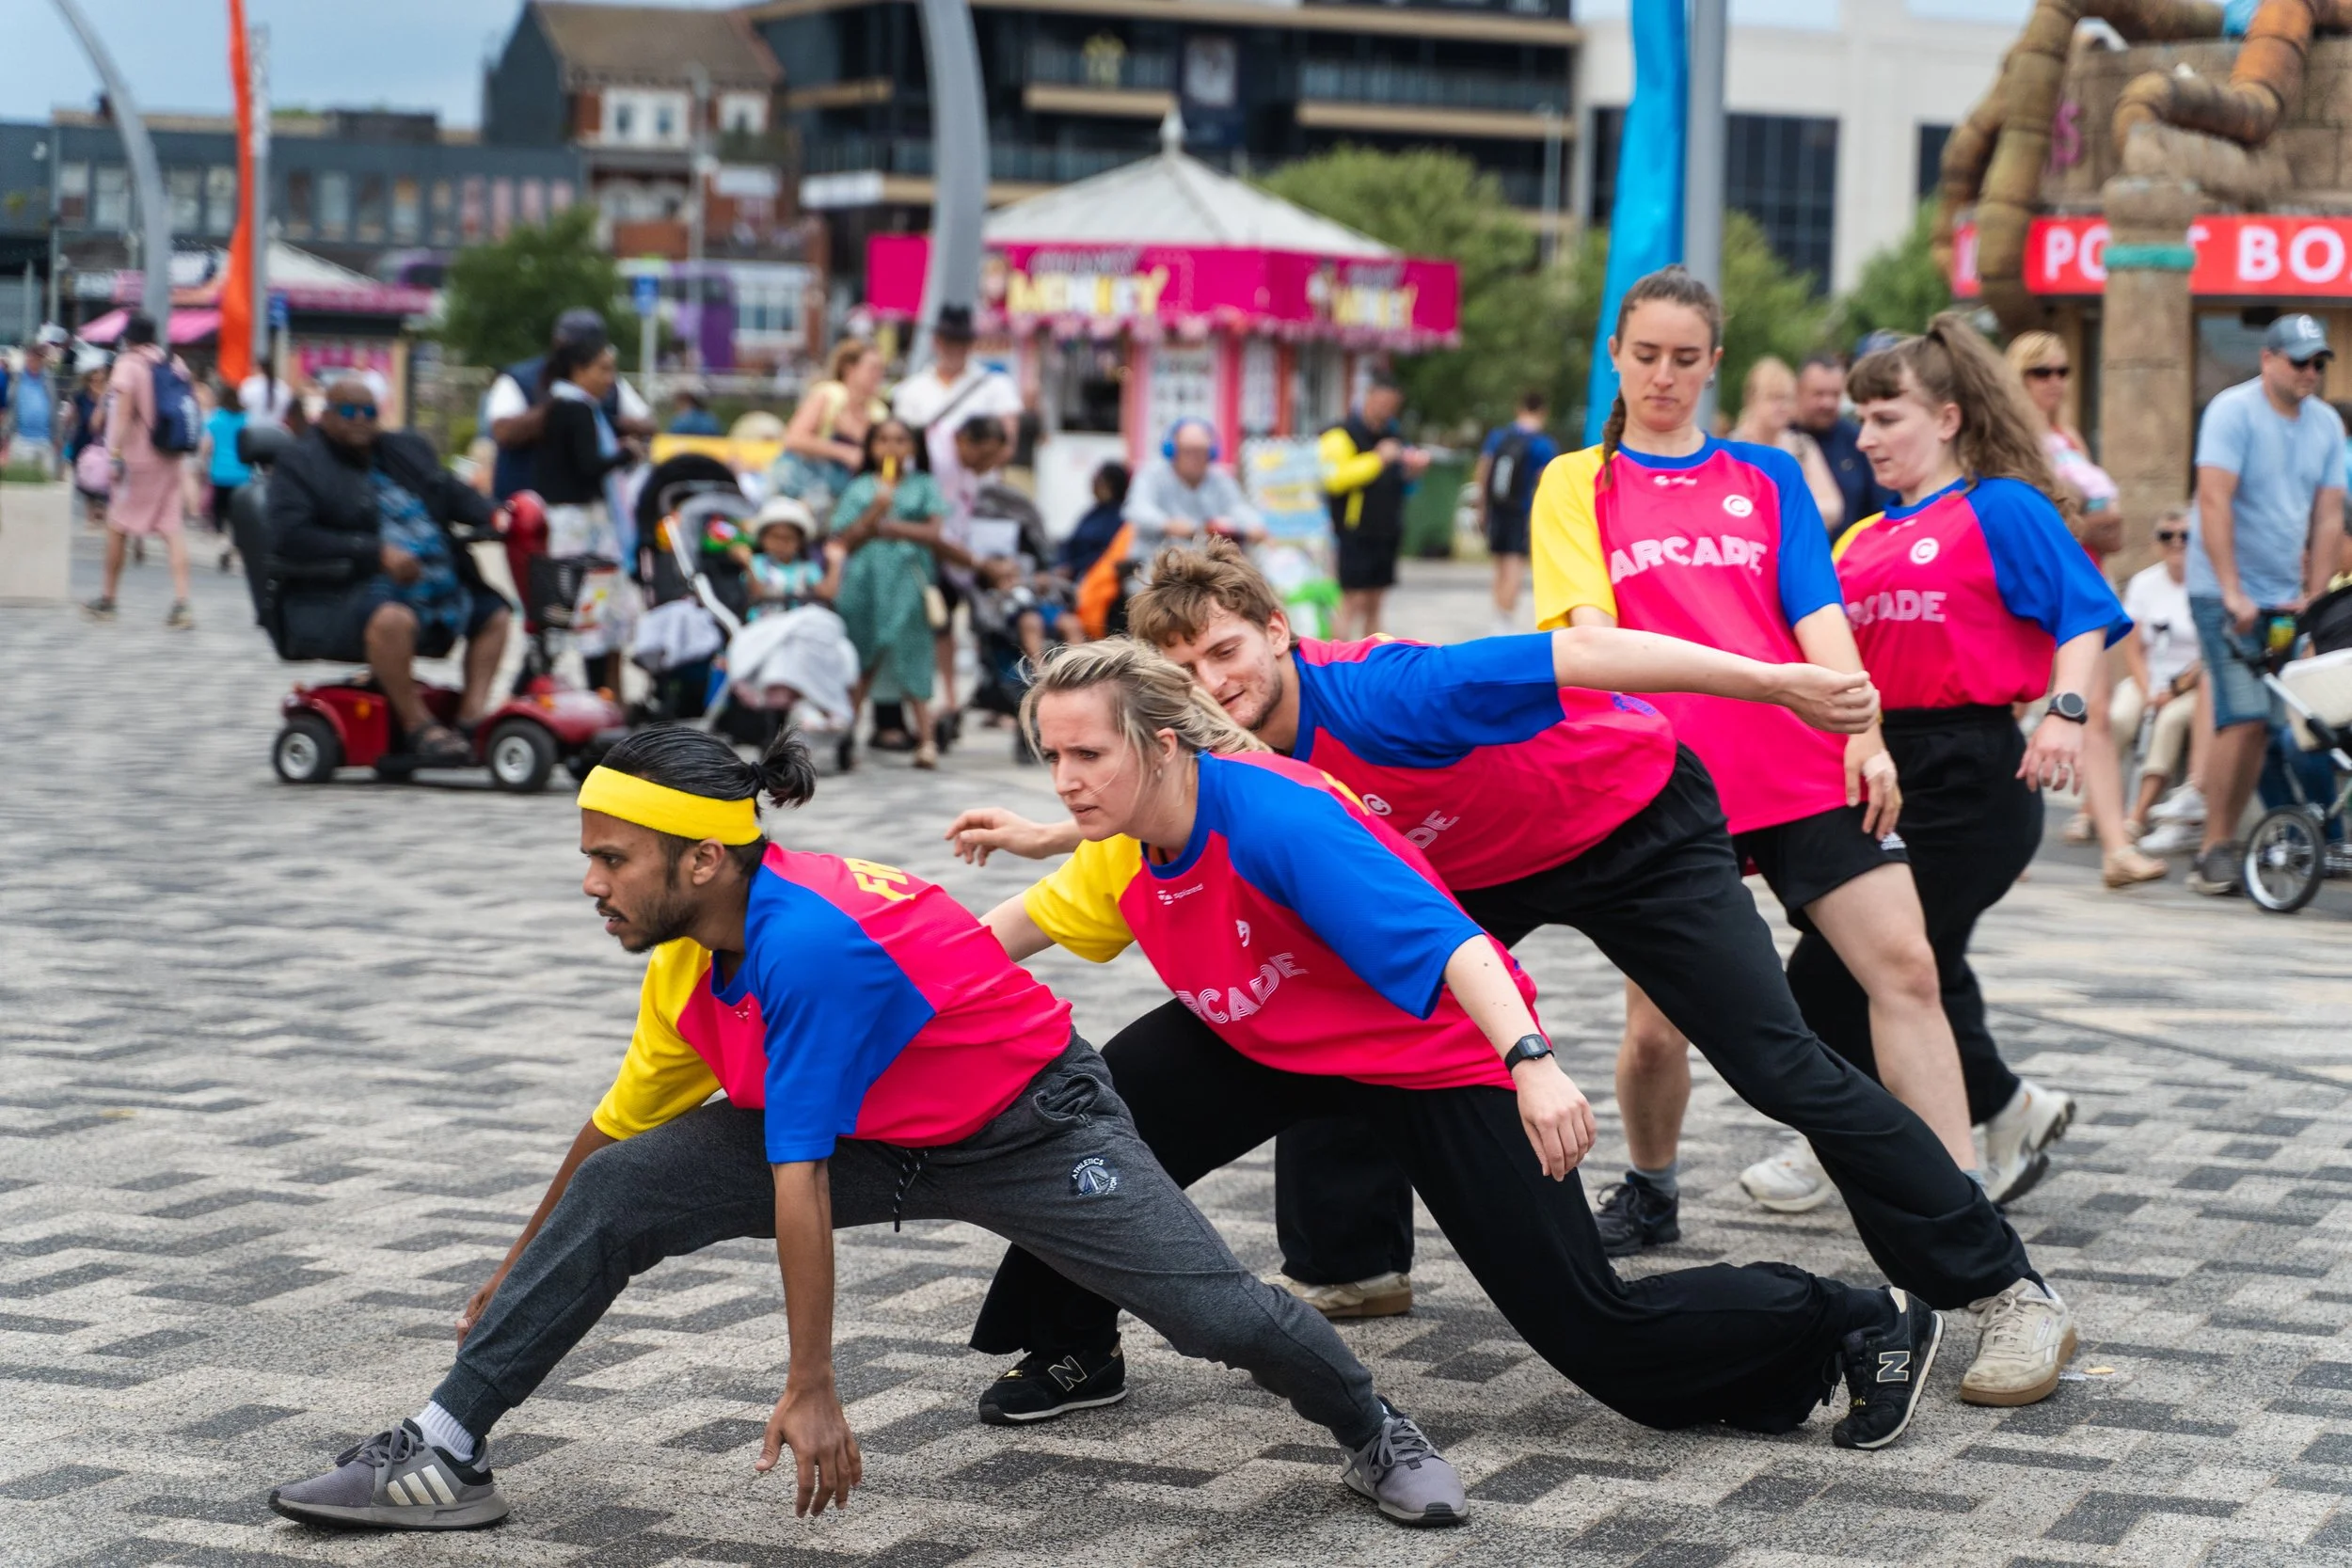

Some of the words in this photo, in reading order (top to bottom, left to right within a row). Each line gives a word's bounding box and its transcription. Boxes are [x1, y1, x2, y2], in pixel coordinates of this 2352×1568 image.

[2044, 225, 2210, 281] PO
[2236, 225, 2352, 282] BO
[1611, 534, 1768, 585] ARCADE
[1175, 952, 1310, 1024] RCADE
[1072, 1157, 1104, 1180] ATHLETICS
